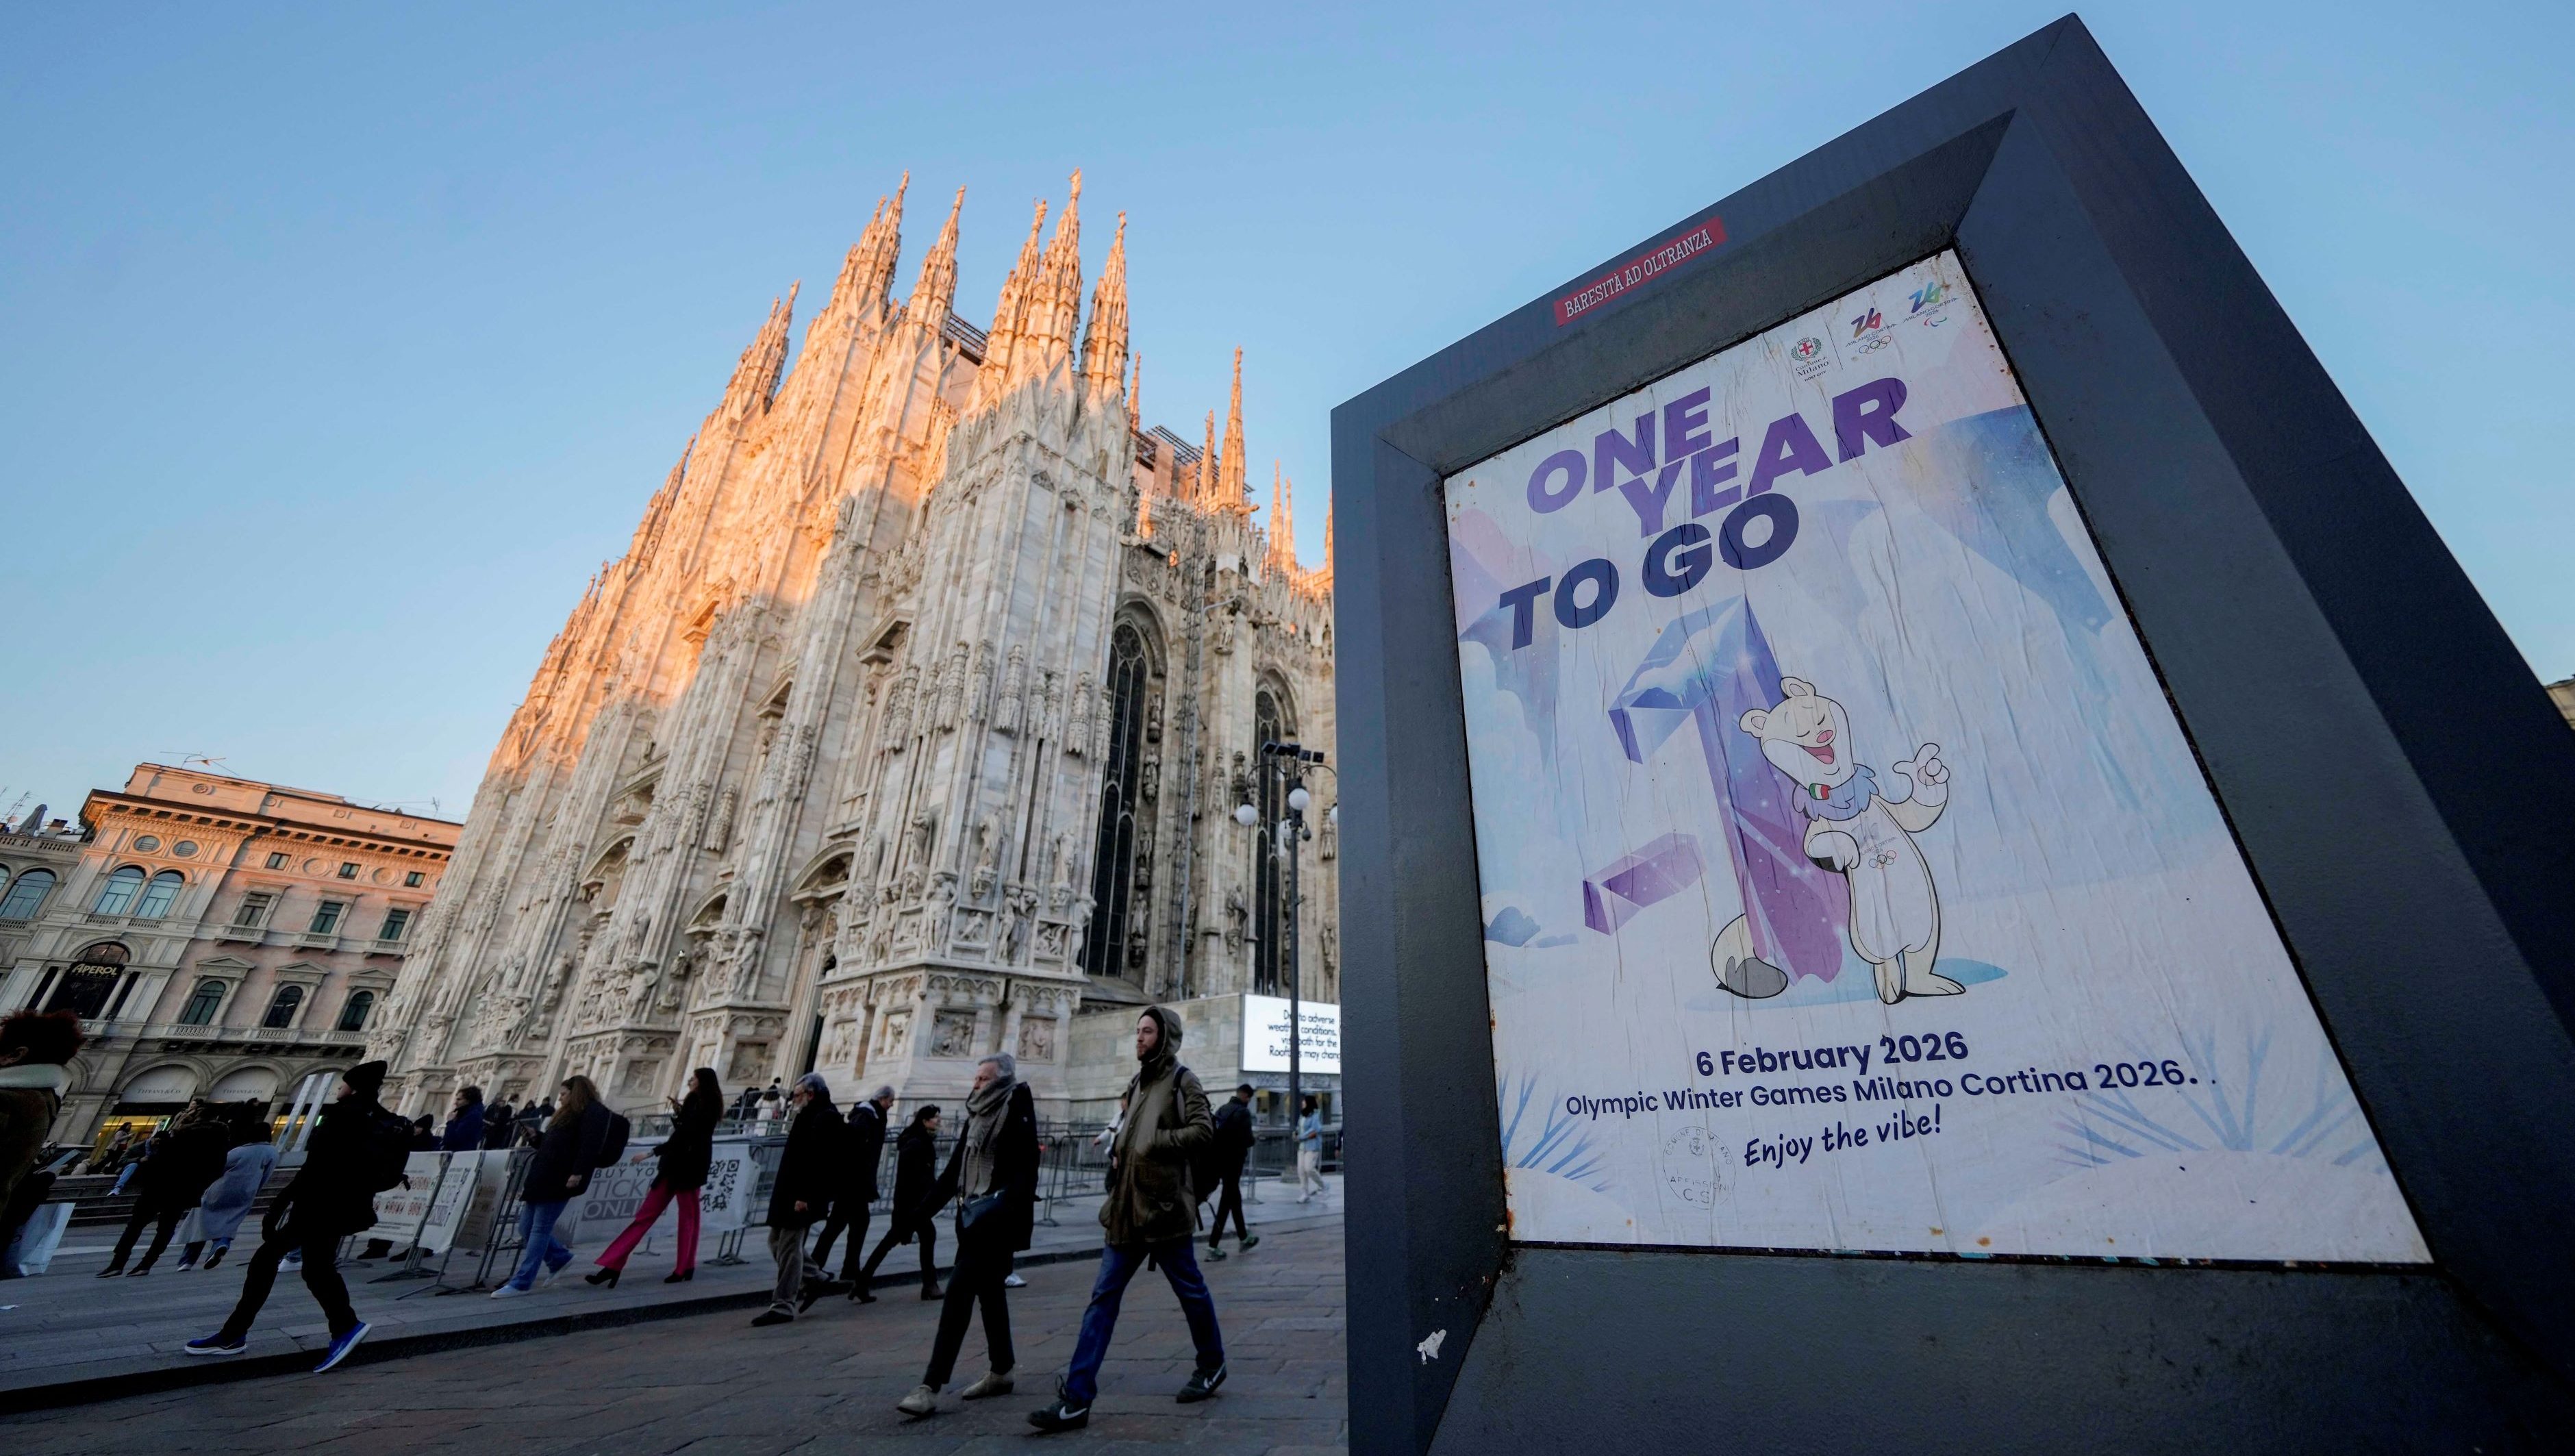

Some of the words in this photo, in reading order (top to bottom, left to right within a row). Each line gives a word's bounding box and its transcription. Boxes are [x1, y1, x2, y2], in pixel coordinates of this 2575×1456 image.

[1564, 273, 1624, 318] BARESITÀ
[1626, 265, 1642, 288] AD
[1644, 229, 1713, 276] OLTRANZA
[1903, 309, 1930, 323] MILANO
[1931, 297, 1959, 310] CORTINA
[1846, 334, 1870, 347] MILANO
[1871, 323, 1898, 336] CORTINA
[1798, 361, 1829, 377] Milano
[1527, 386, 1712, 514] ONE
[1618, 377, 1913, 539] YEAR
[1499, 558, 1620, 651] TO
[1642, 493, 1799, 598] GO
[72, 964, 118, 975] APEROL
[1308, 1012, 1335, 1024] adverse
[1316, 1035, 1325, 1046] for
[1327, 1037, 1337, 1048] the
[1304, 1051, 1320, 1062] may
[1321, 1048, 1340, 1063] chang
[1696, 1051, 1714, 1077] 6
[1722, 1045, 1872, 1075] February
[1879, 1031, 1969, 1064] 2026
[1566, 1090, 1659, 1121] Olympic
[1663, 1088, 1744, 1110] Winter
[1750, 1085, 1847, 1106] Games
[1853, 1076, 1953, 1101] Milano
[1961, 1067, 2089, 1096] Cortina
[2094, 1060, 2198, 1089] 2026.
[1666, 1129, 1690, 1156] COMUNE
[1696, 1128, 1704, 1136] DI
[1744, 1133, 1813, 1169] Enjoy
[1821, 1121, 1869, 1152] the
[1876, 1103, 1941, 1143] vibe!
[594, 1168, 626, 1178] BUY
[636, 1167, 655, 1177] YO
[1670, 1176, 1730, 1192] AFFISSIONI
[592, 1179, 651, 1198] TICK
[583, 1200, 646, 1218] ONLI
